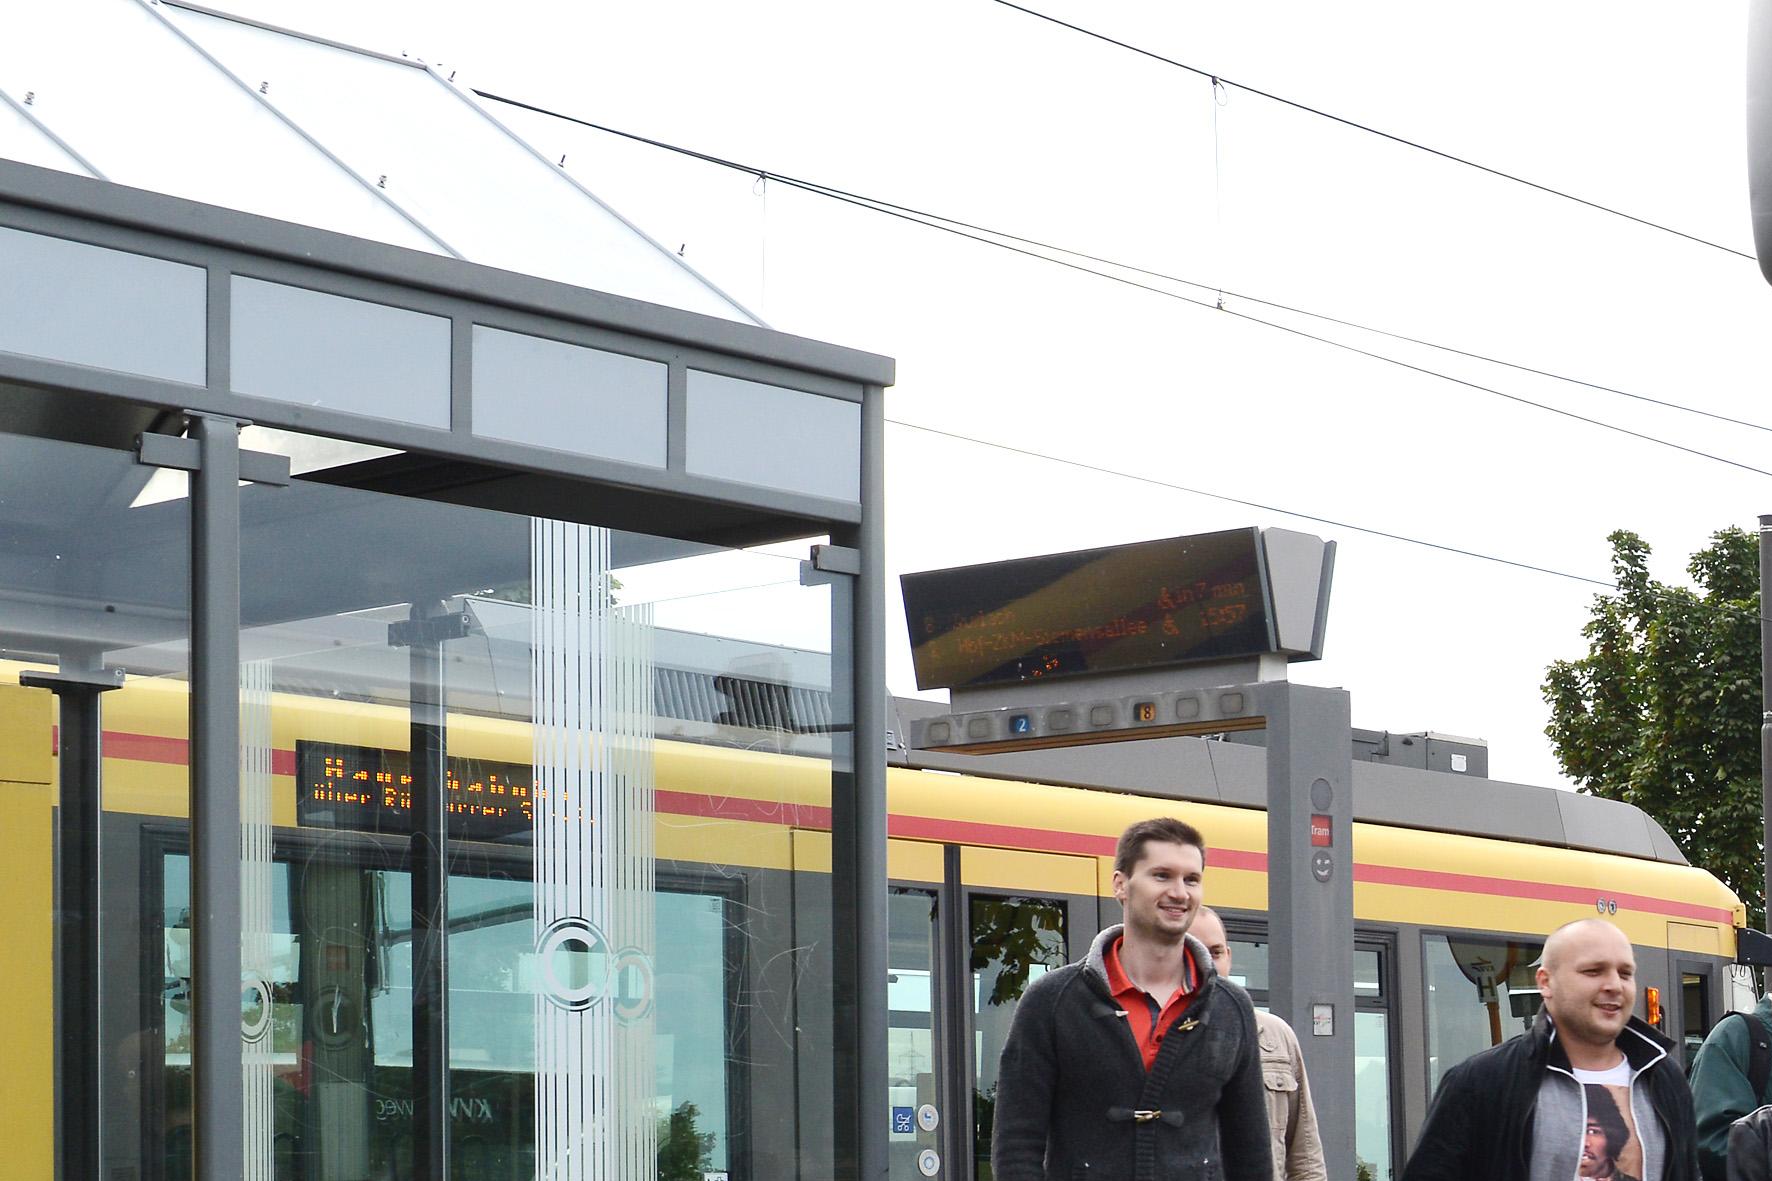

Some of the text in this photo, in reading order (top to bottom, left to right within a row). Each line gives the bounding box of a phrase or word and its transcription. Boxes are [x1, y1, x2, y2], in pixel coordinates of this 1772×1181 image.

[1144, 706, 1151, 720] 8
[1018, 718, 1026, 733] 2
[1311, 824, 1330, 836] Tram
